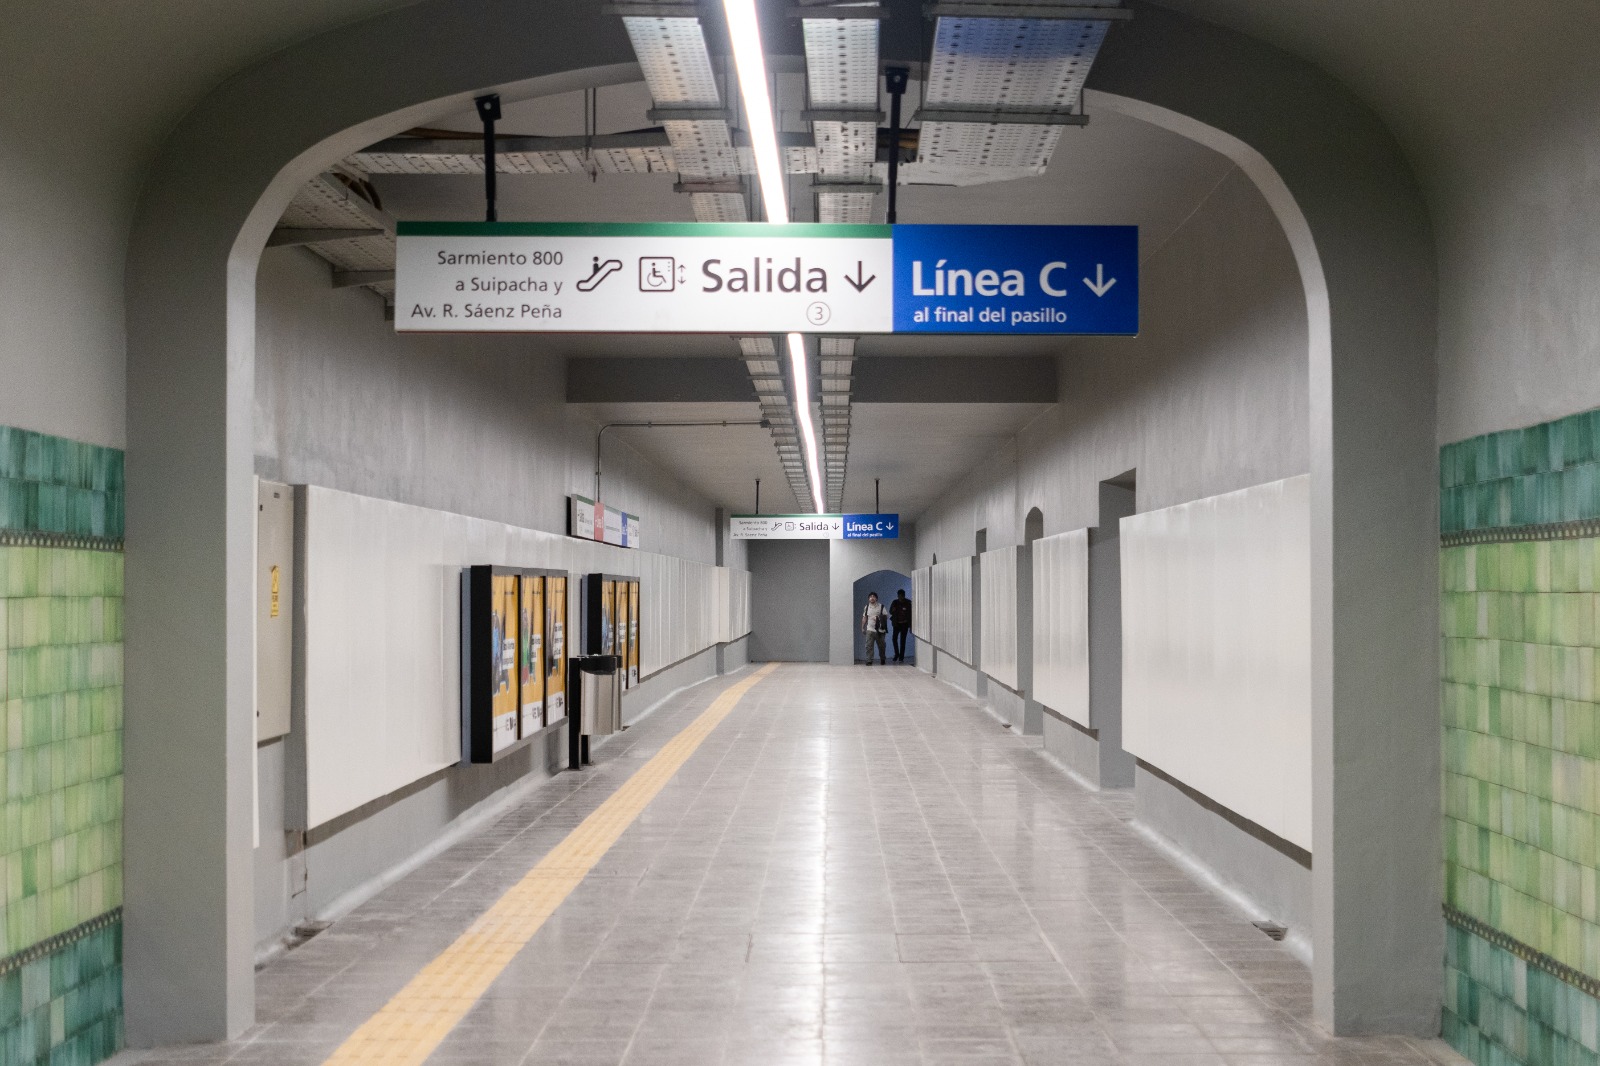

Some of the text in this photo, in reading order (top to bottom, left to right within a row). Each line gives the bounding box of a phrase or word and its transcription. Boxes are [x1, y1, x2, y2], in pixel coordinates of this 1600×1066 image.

[437, 250, 563, 266] Sarmiento 800
[703, 258, 827, 292] Salida
[913, 259, 1067, 297] Línea C
[455, 276, 563, 296] a Suipacha y
[410, 303, 561, 318] Av. R. Sáenz Peña
[814, 307, 824, 320] 3
[914, 307, 1066, 325] al final del pasillo
[800, 522, 828, 530] Salida
[847, 522, 882, 531] Línea C
